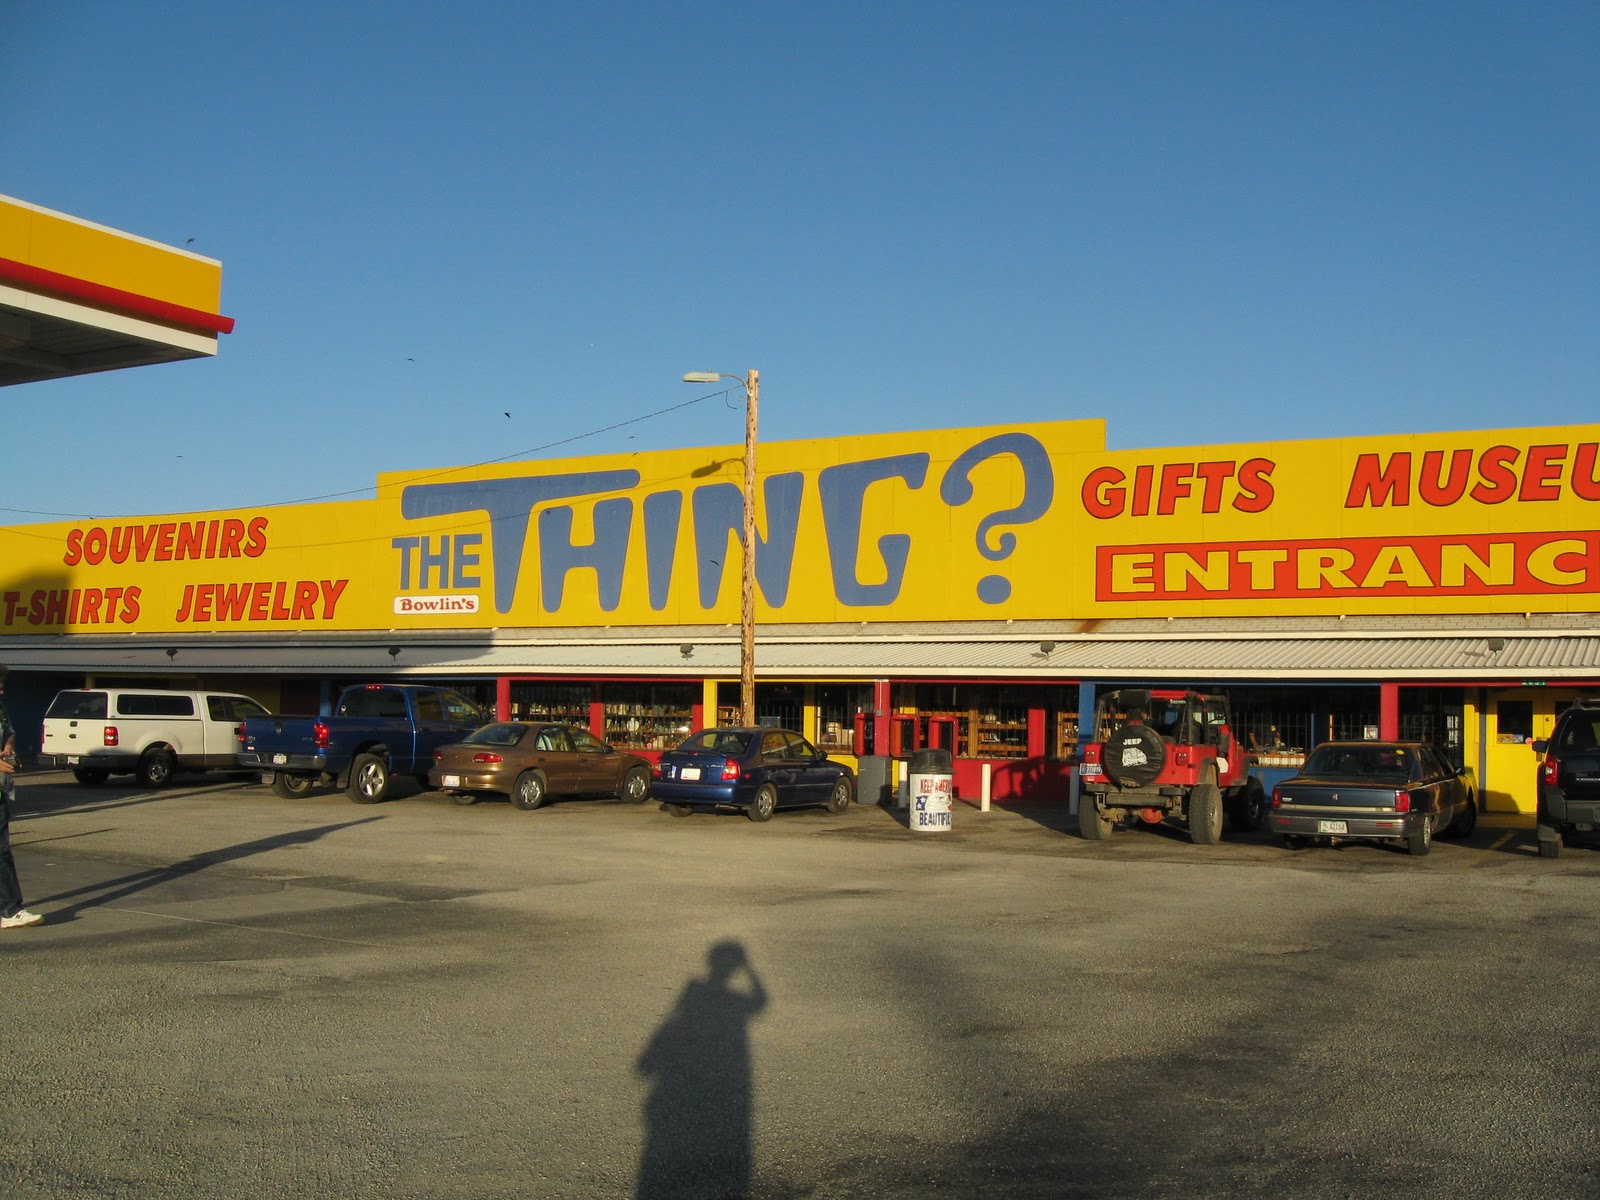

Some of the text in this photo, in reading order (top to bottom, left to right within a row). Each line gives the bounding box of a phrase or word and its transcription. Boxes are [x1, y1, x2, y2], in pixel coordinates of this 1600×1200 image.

[1081, 457, 1276, 520] GIFTS
[63, 516, 269, 567] SOUVENIRS
[392, 533, 482, 590] THE
[1110, 538, 1588, 594] ENTRANC
[3, 585, 142, 626] T-SHIRTS
[175, 579, 349, 623] JEWELRY
[400, 598, 475, 611] Bowlin's
[1123, 738, 1142, 746] JEEP
[920, 779, 933, 793] KEEP
